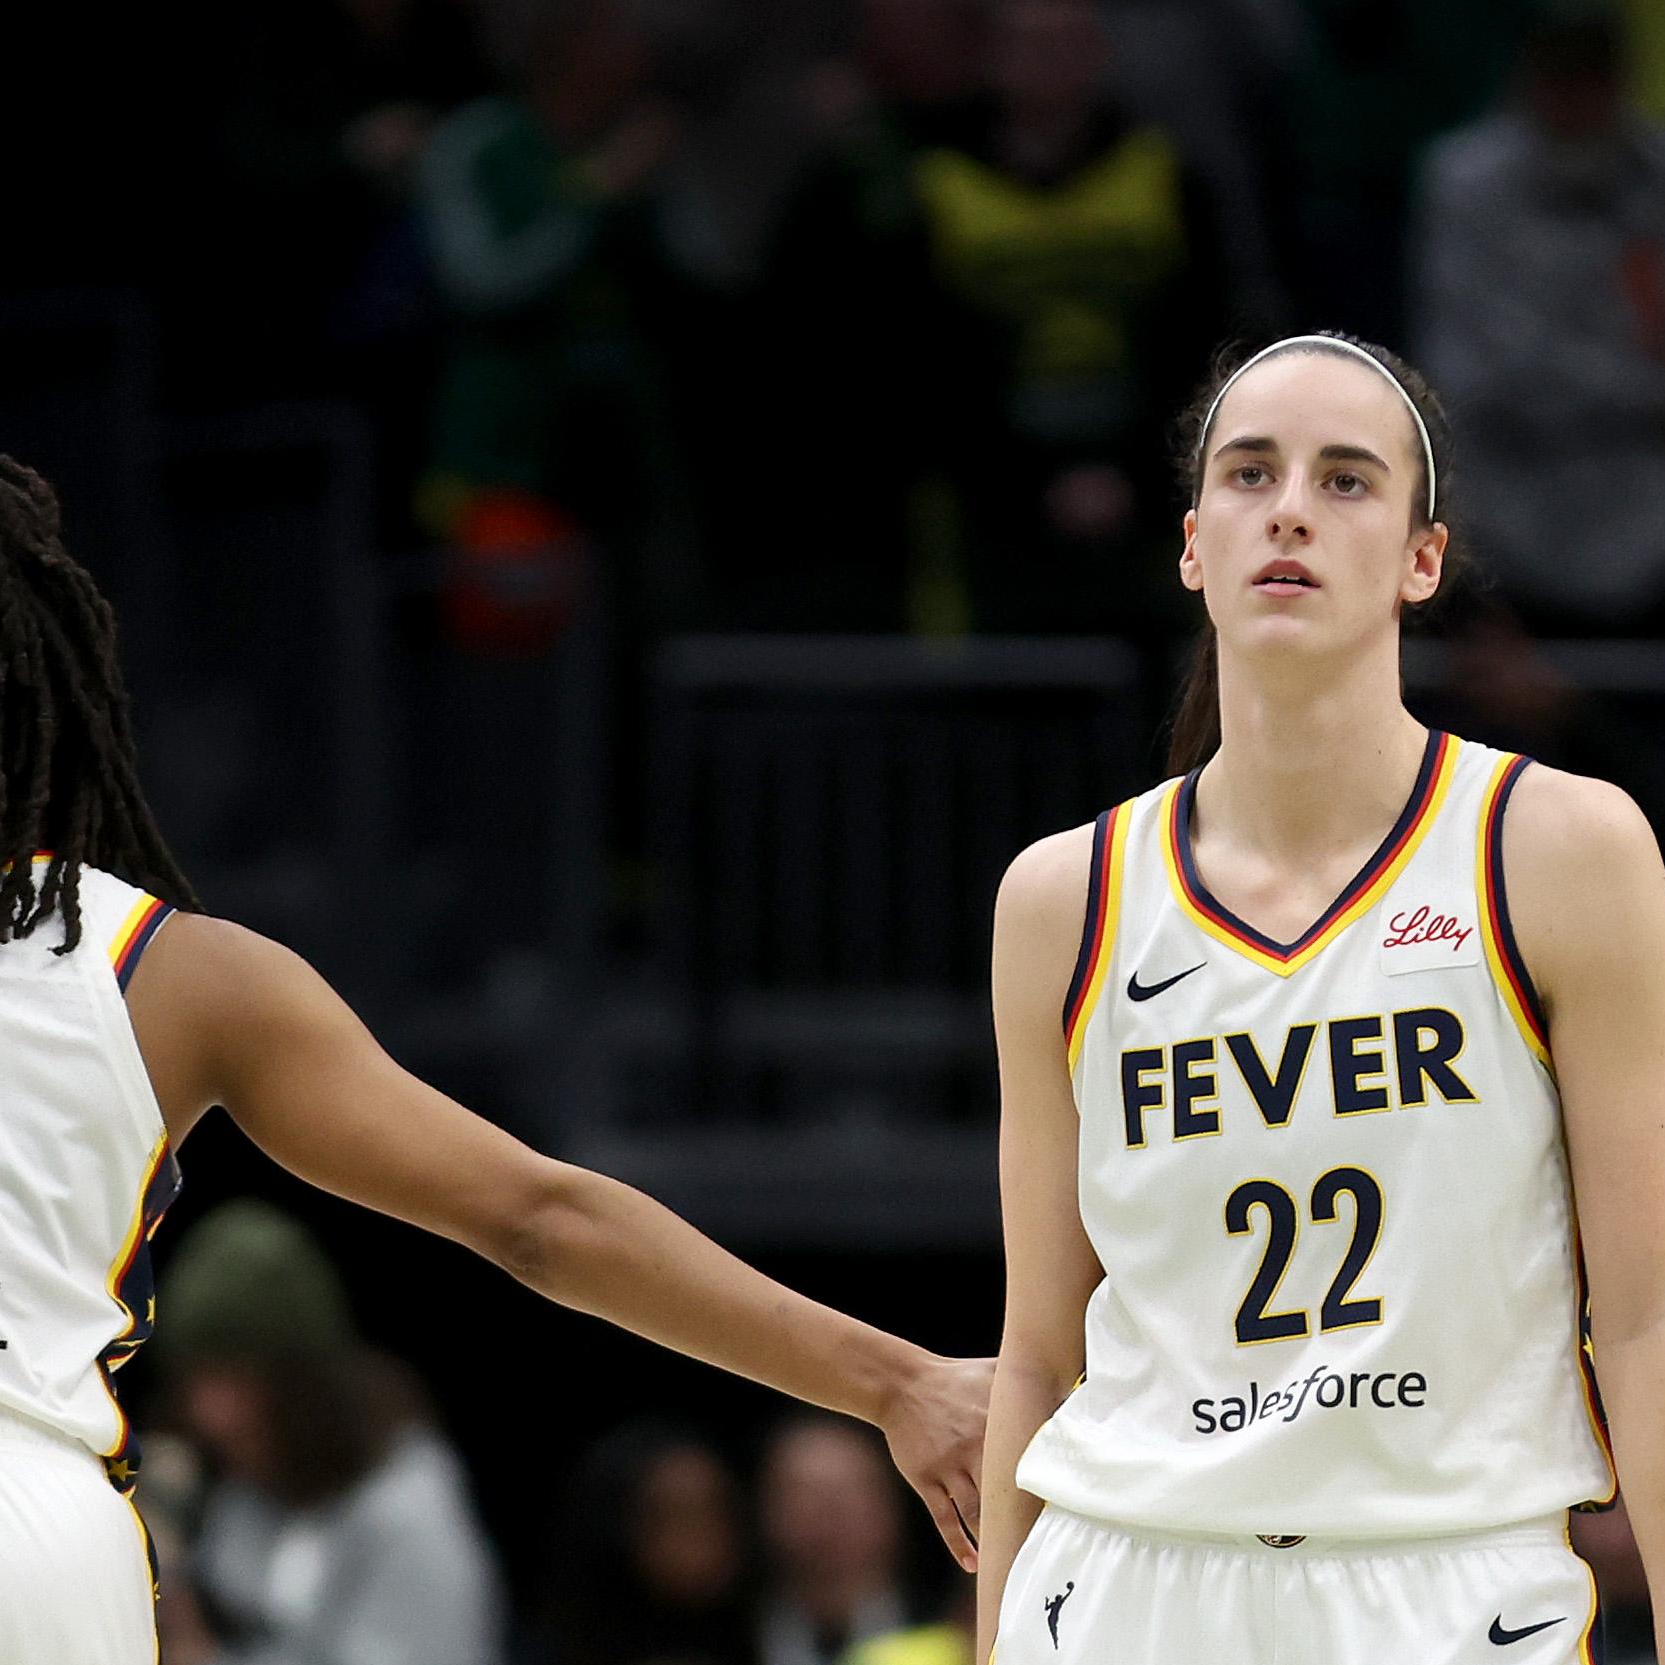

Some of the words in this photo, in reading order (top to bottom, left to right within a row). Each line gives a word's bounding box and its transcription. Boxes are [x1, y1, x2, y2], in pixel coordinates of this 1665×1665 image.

[1383, 906, 1473, 950] Lilly
[1120, 1006, 1481, 1151] FEVER
[1225, 1164, 1386, 1348] 22
[1192, 1365, 1428, 1434] salesforce
